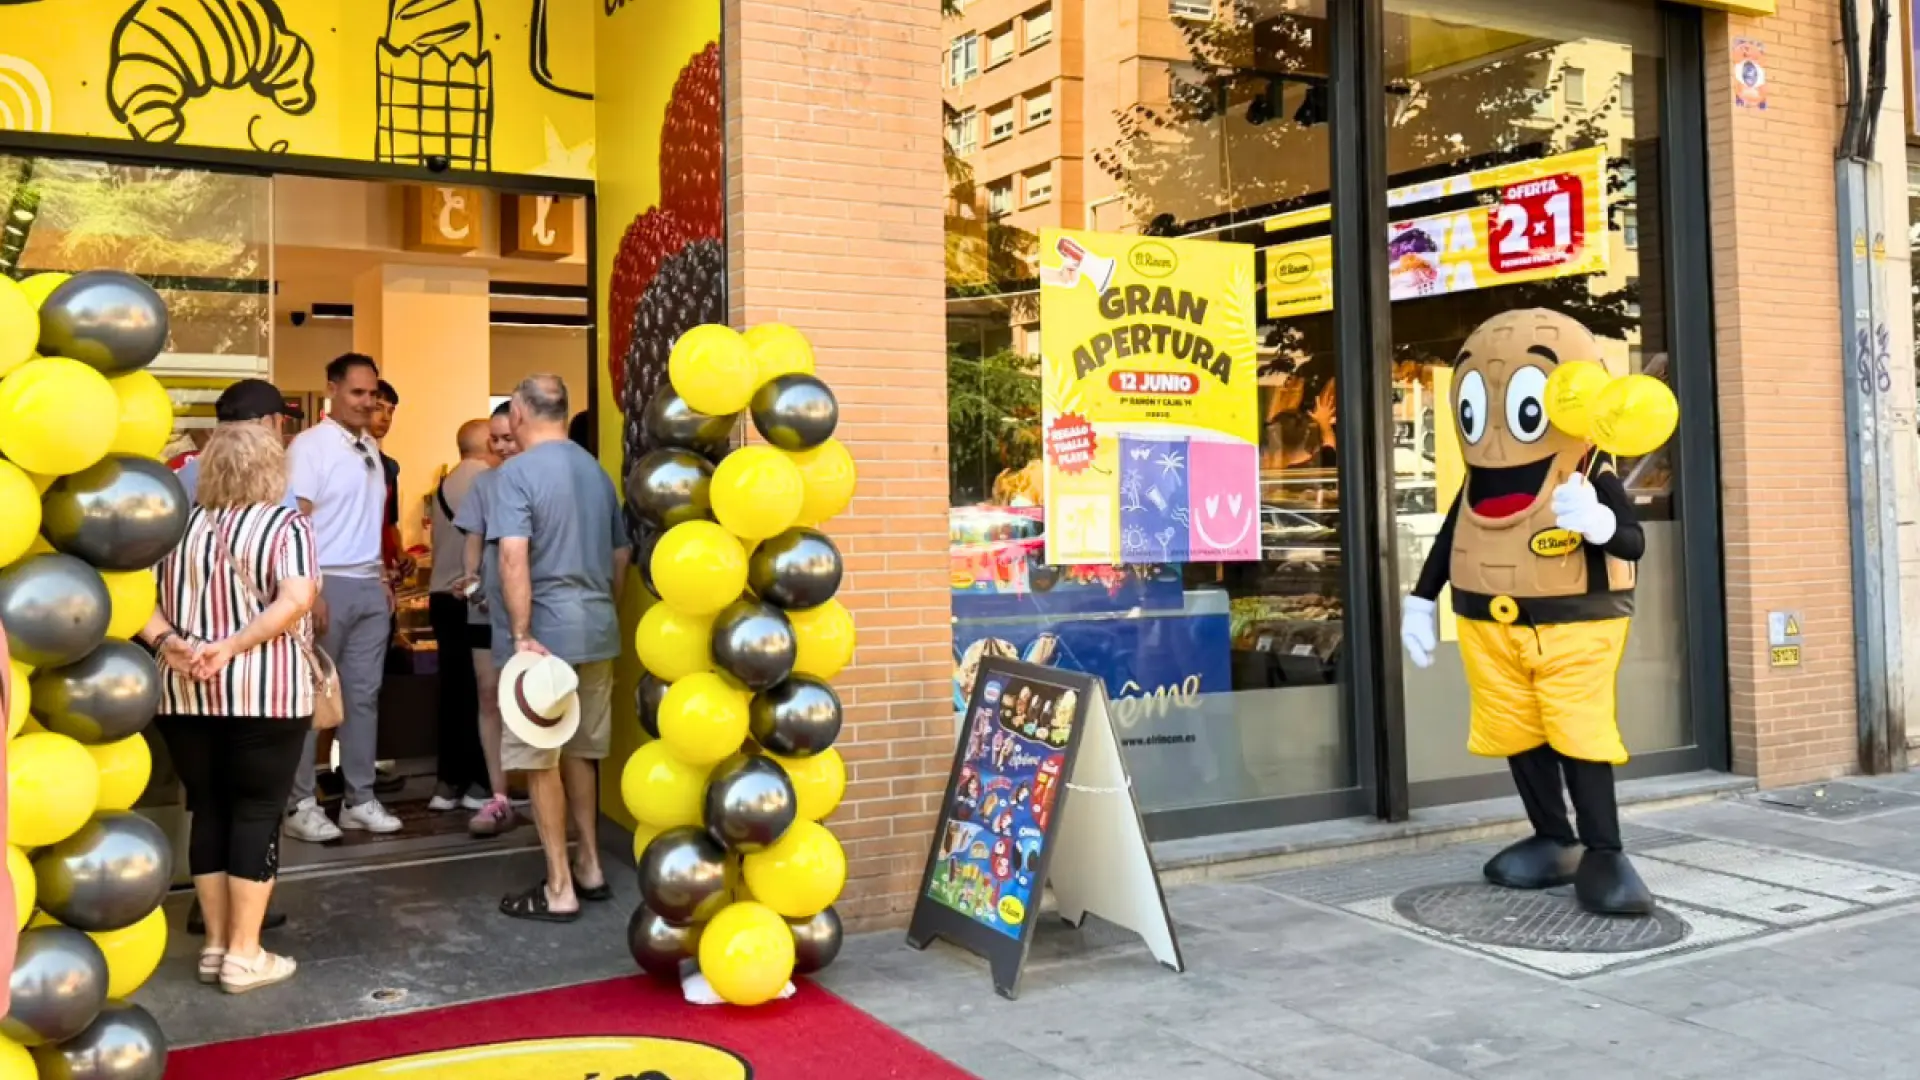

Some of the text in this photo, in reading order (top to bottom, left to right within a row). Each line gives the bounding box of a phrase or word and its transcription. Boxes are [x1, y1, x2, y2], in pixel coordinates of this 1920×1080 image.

[1506, 179, 1558, 200] OFERTA
[1099, 284, 1208, 325] GRAN
[1072, 324, 1232, 385] APERTURA
[1119, 372, 1193, 392] 12 JUNIO
